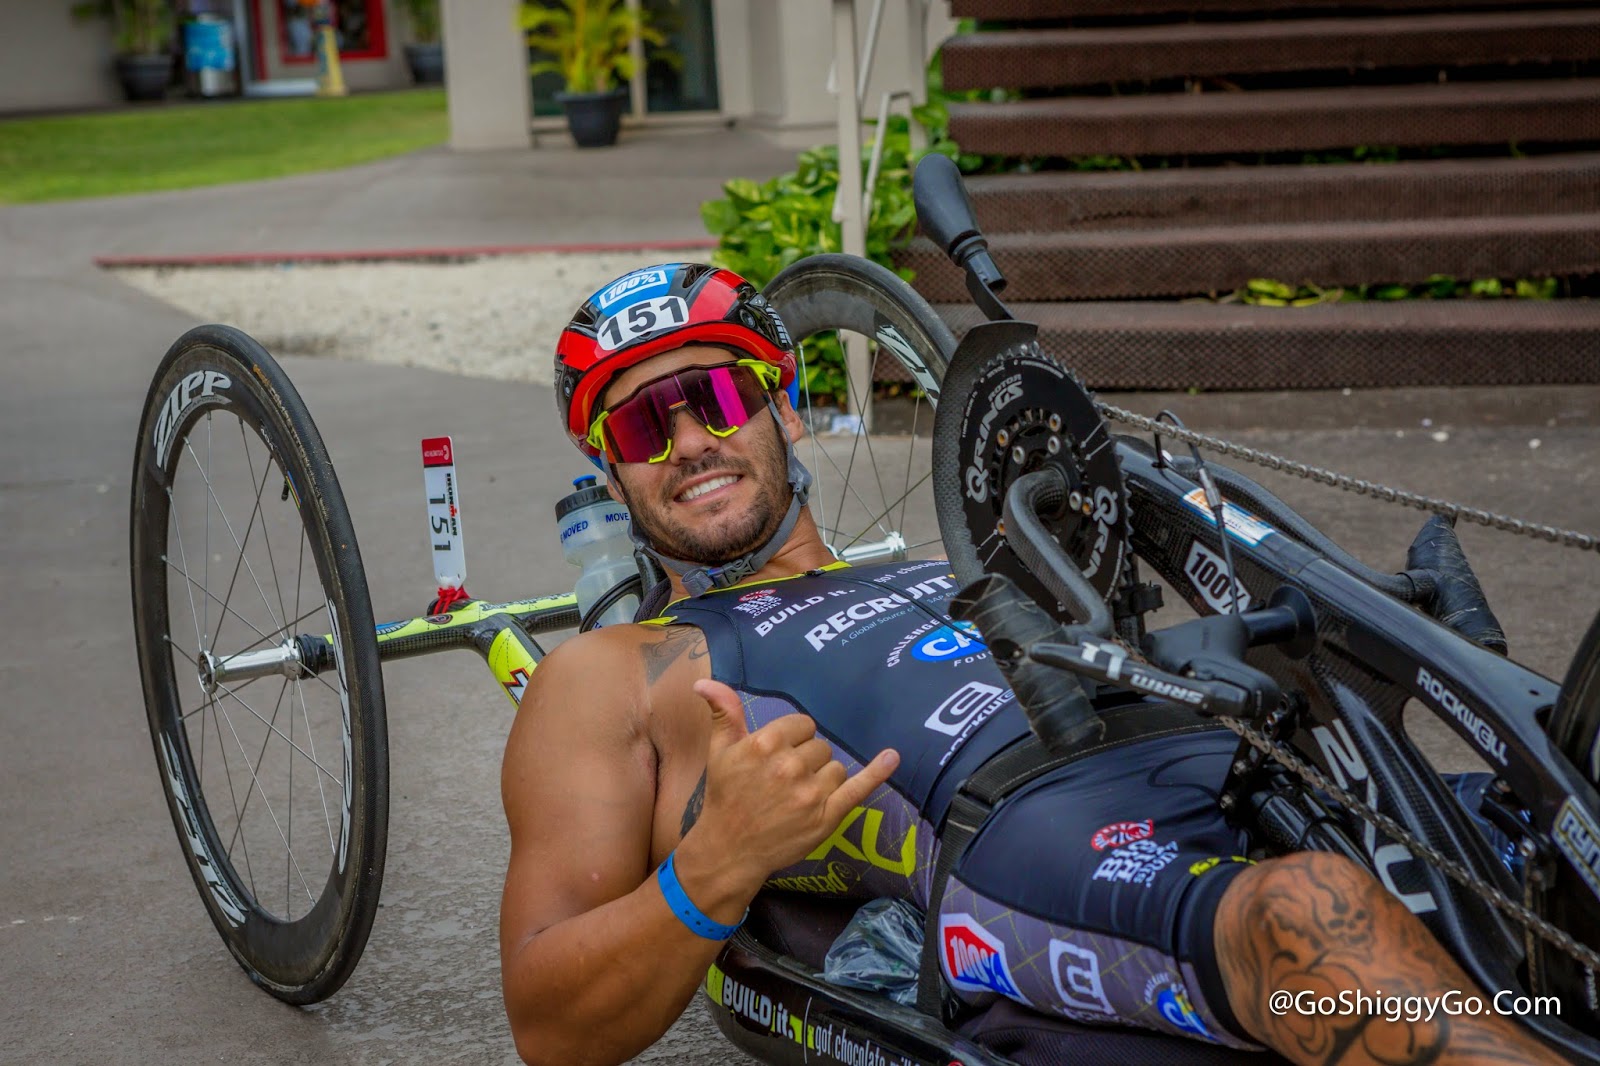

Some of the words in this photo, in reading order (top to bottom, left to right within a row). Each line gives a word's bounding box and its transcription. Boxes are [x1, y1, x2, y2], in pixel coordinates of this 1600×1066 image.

[604, 272, 656, 301] 100%
[602, 297, 685, 346] 151
[154, 370, 233, 468] ZIPP
[429, 493, 451, 551] 151
[562, 520, 588, 541] MOVED
[605, 512, 630, 523] MOVE
[754, 595, 825, 638] BUILD
[841, 638, 849, 647] A
[849, 621, 877, 640] Global
[878, 610, 906, 625] Source
[1416, 666, 1509, 766] ROCKWELL
[723, 976, 772, 1027] BUILD
[776, 1005, 794, 1040] it.
[815, 1024, 833, 1056] got
